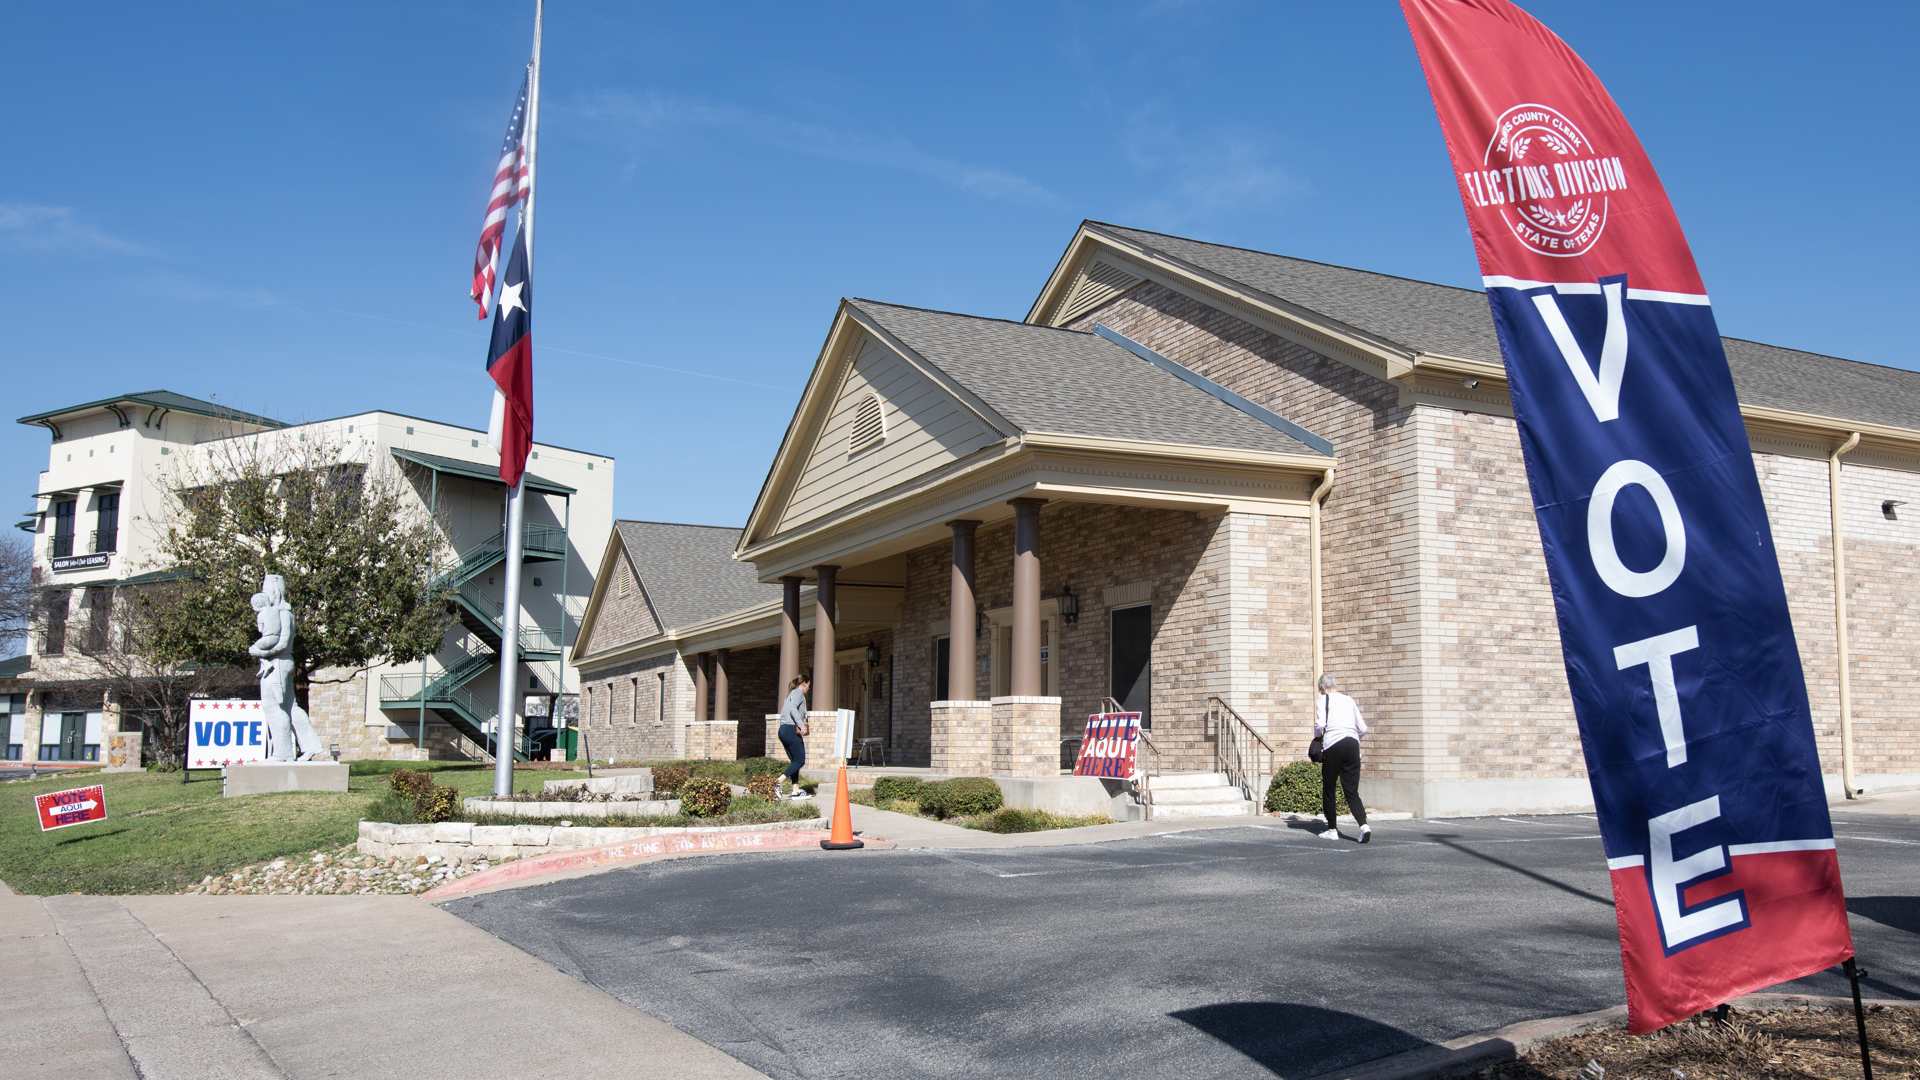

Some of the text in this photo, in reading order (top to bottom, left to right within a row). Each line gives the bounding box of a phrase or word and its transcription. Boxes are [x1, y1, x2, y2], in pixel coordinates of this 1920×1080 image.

[1496, 112, 1582, 152] TRAVIS COUNTY CLERK
[1464, 156, 1627, 207] ELECTIONS DIVISION
[1516, 212, 1600, 249] STATE OF TEXAS
[53, 560, 69, 568] SALON
[86, 556, 106, 565] LEASING
[1532, 283, 1745, 949] VOTE
[194, 721, 262, 747] VOTE
[1088, 714, 1139, 741] VOTE
[1083, 737, 1128, 759] AQUI
[1079, 757, 1126, 778] HERE
[52, 791, 88, 806] VOTE
[60, 803, 83, 813] AQUI
[55, 810, 91, 825] HERE
[631, 842, 662, 855] ZONE
